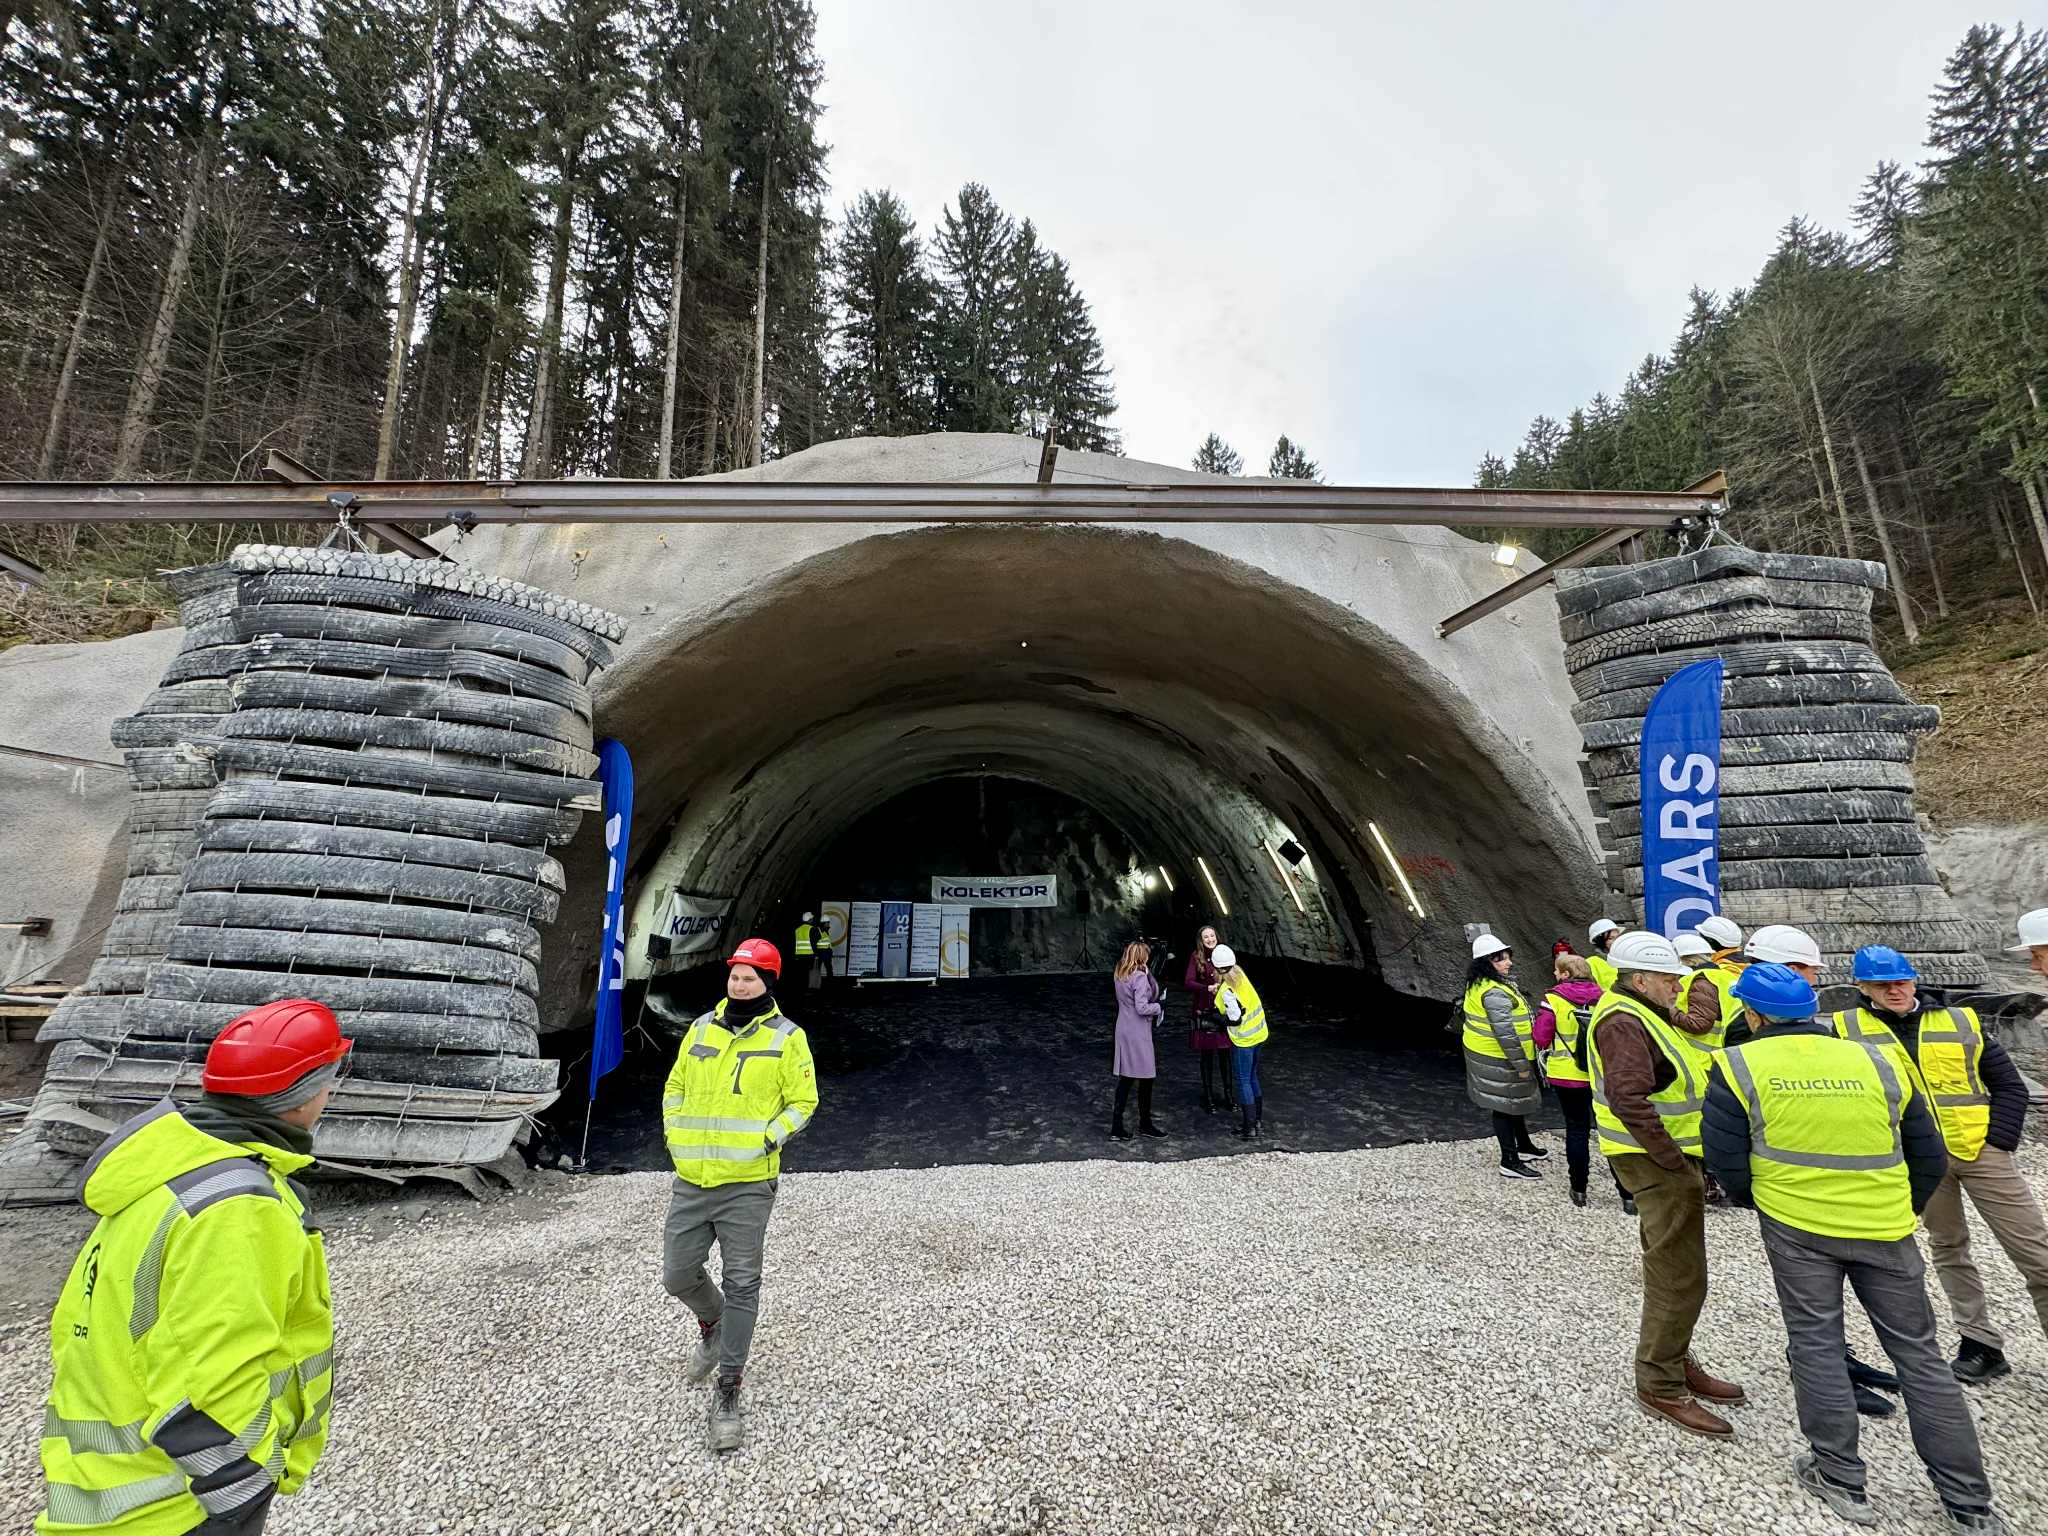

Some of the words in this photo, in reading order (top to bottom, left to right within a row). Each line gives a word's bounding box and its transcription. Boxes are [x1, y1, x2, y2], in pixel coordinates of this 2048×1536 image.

[1659, 753, 1716, 941] DARS
[940, 885, 1048, 898] KOLEKTOR
[1768, 1077, 1865, 1091] Structum
